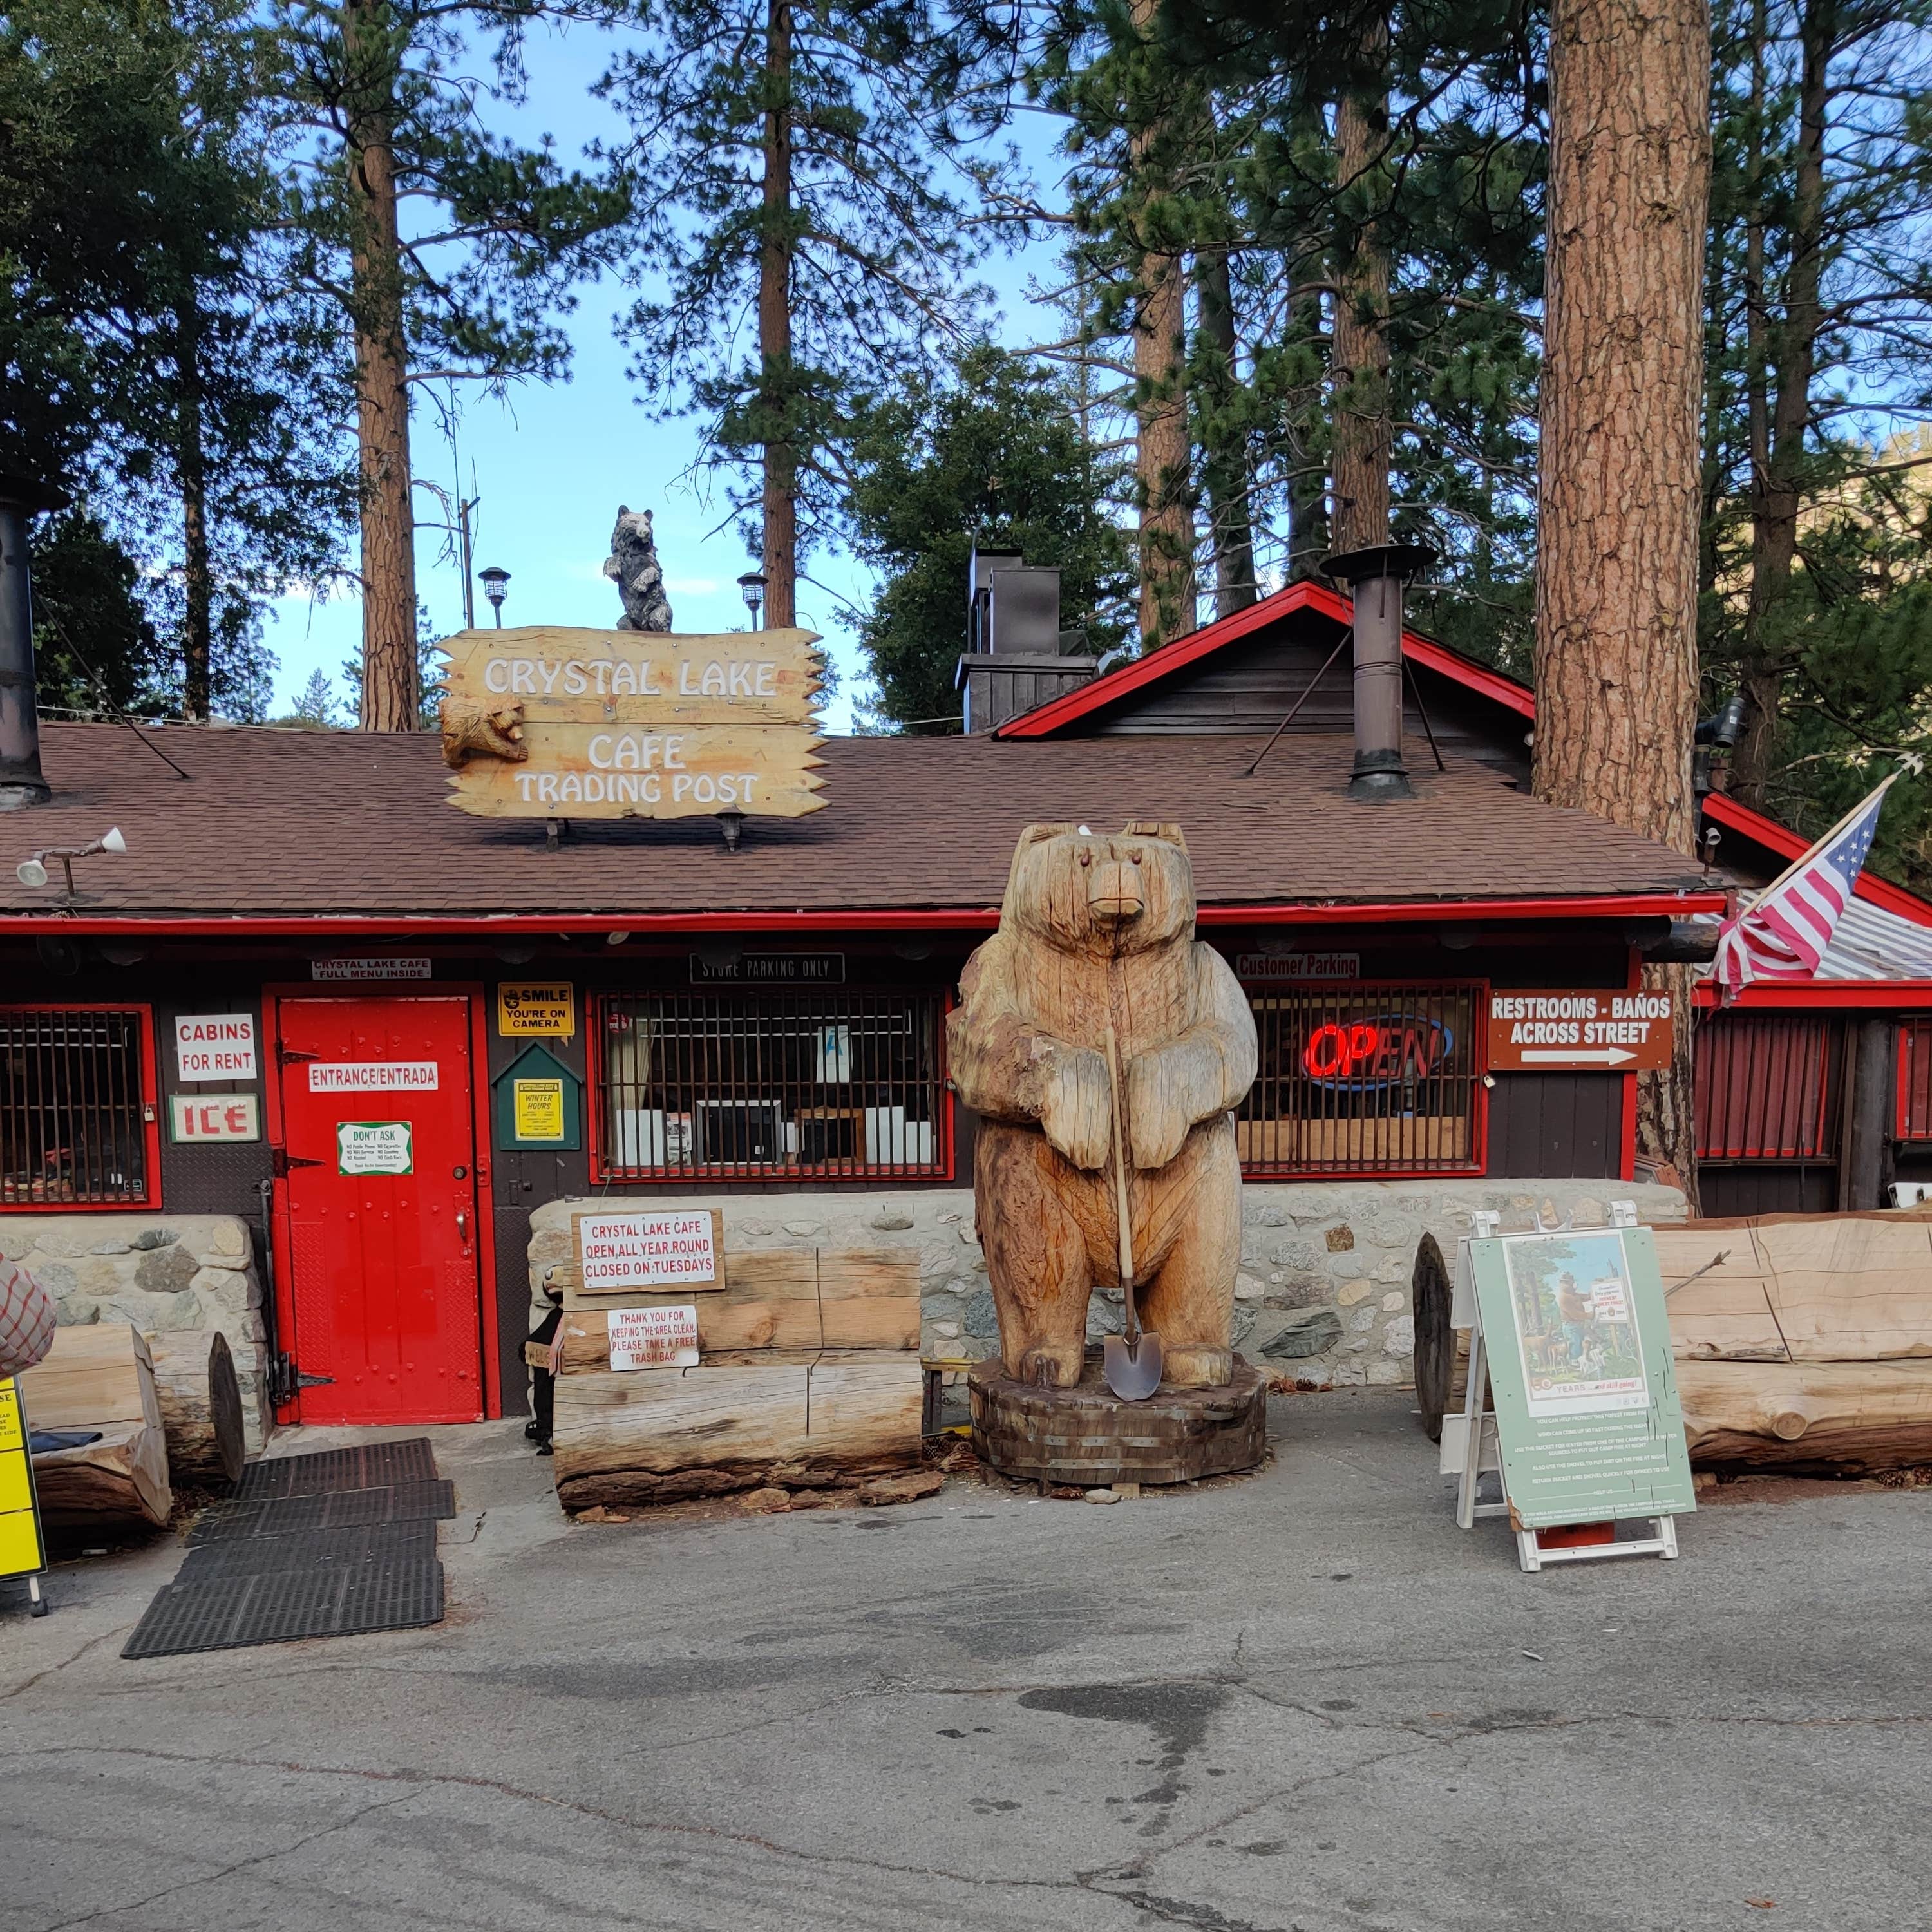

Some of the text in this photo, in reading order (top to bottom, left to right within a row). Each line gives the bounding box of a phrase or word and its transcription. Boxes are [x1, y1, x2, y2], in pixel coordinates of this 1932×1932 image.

[484, 658, 777, 697] CRYSTAL LAKE
[588, 735, 686, 769] CAFE
[515, 773, 759, 804] TRADING POST
[314, 960, 363, 969] CRYSTAL
[748, 960, 795, 977] PARKING
[802, 960, 829, 977] ONLY
[1240, 954, 1356, 979] Customer Parking
[522, 990, 568, 1001] SMILE
[1492, 998, 1596, 1019] RESTROOMS
[1612, 992, 1670, 1019] BAÑOS
[180, 1023, 251, 1042] CABINS
[1511, 1022, 1650, 1044] ACROSS STREET
[1308, 1025, 1440, 1078] OPEN
[182, 1053, 251, 1071] FOR RENT
[312, 1067, 435, 1086] ENTRANCE/ENTRADA
[184, 1101, 247, 1135] ICE
[354, 1131, 395, 1141] DON'T ASK
[592, 1220, 701, 1238] CRYSTAL LAKE CAFE
[619, 1243, 638, 1257] ALL
[640, 1242, 668, 1255] YEAR
[672, 1239, 709, 1253] ROUND
[585, 1258, 712, 1278] CLOSED ON TUESDAYS
[620, 1311, 684, 1325] THANK YOU FOR
[612, 1327, 639, 1338] KEEPING
[641, 1326, 654, 1336] THE
[655, 1325, 672, 1336] AREA
[612, 1336, 695, 1352] PLEASE TAKE A FREE
[630, 1351, 676, 1364] TRASH BAG
